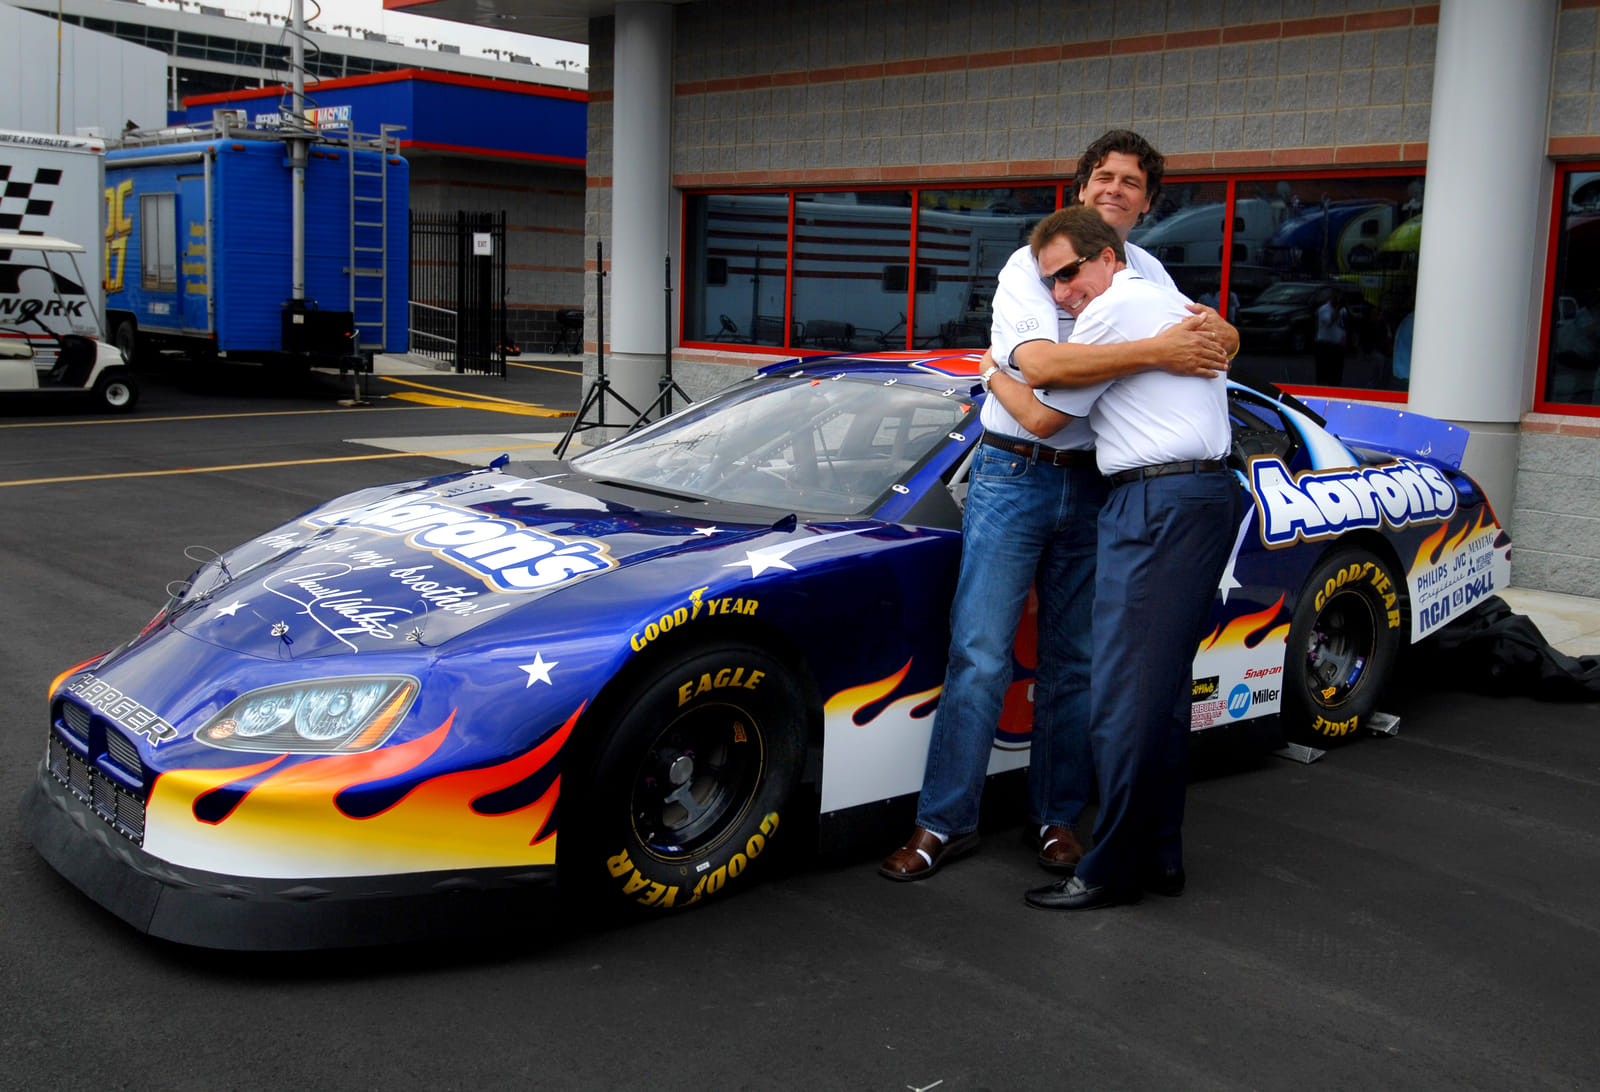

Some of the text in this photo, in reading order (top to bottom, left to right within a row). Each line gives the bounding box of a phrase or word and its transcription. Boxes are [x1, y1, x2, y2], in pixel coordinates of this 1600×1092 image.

[319, 107, 350, 128] NASCAR
[1016, 317, 1039, 333] 99
[1250, 455, 1457, 549] Aaron's
[301, 489, 616, 593] Aaron's
[1468, 533, 1494, 553] MAYTAG
[348, 550, 397, 571] my
[1453, 552, 1467, 571] JVC
[1417, 563, 1448, 592] PHILIPS
[1465, 571, 1494, 605] DELL
[1420, 595, 1450, 632] RCA
[1244, 666, 1282, 680] Snap-on
[678, 667, 766, 708] EAGLE
[1252, 688, 1280, 705] Miller
[1312, 715, 1359, 737] EAGLE
